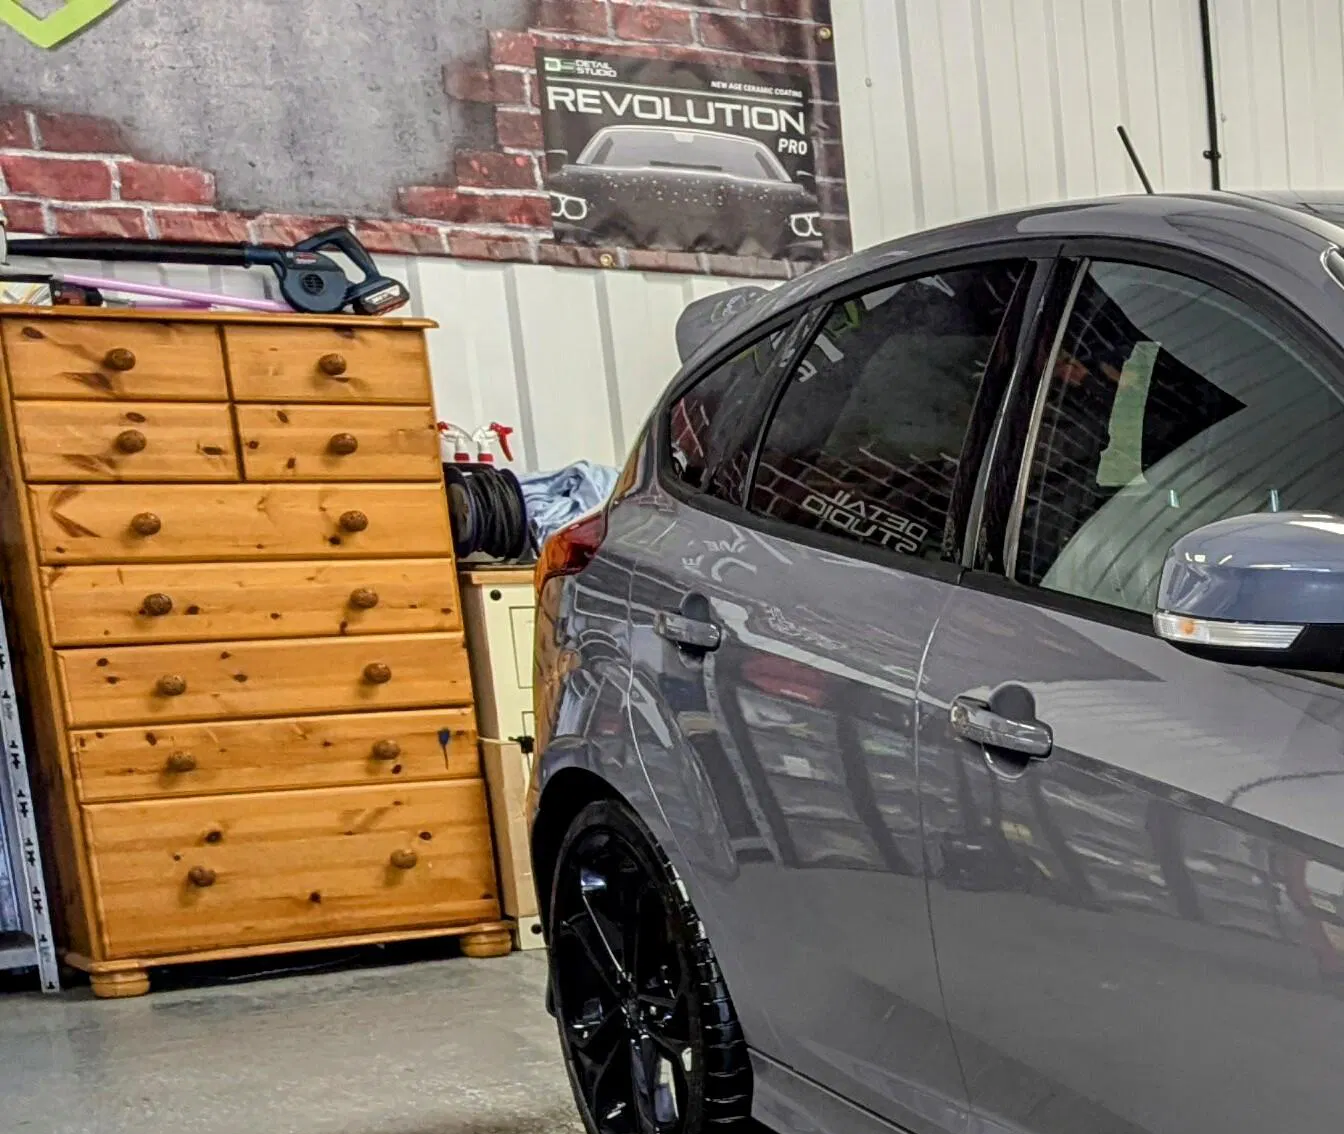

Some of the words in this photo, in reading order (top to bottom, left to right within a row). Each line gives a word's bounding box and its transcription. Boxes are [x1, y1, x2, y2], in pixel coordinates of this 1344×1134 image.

[575, 60, 612, 70] DETAIL
[576, 66, 617, 77] STUDIO
[711, 81, 728, 89] NEW
[728, 82, 742, 91] AGE
[743, 84, 774, 95] CERAMIC
[774, 88, 803, 98] COATING
[546, 86, 806, 135] REVOLUTION
[778, 137, 808, 155] PRO
